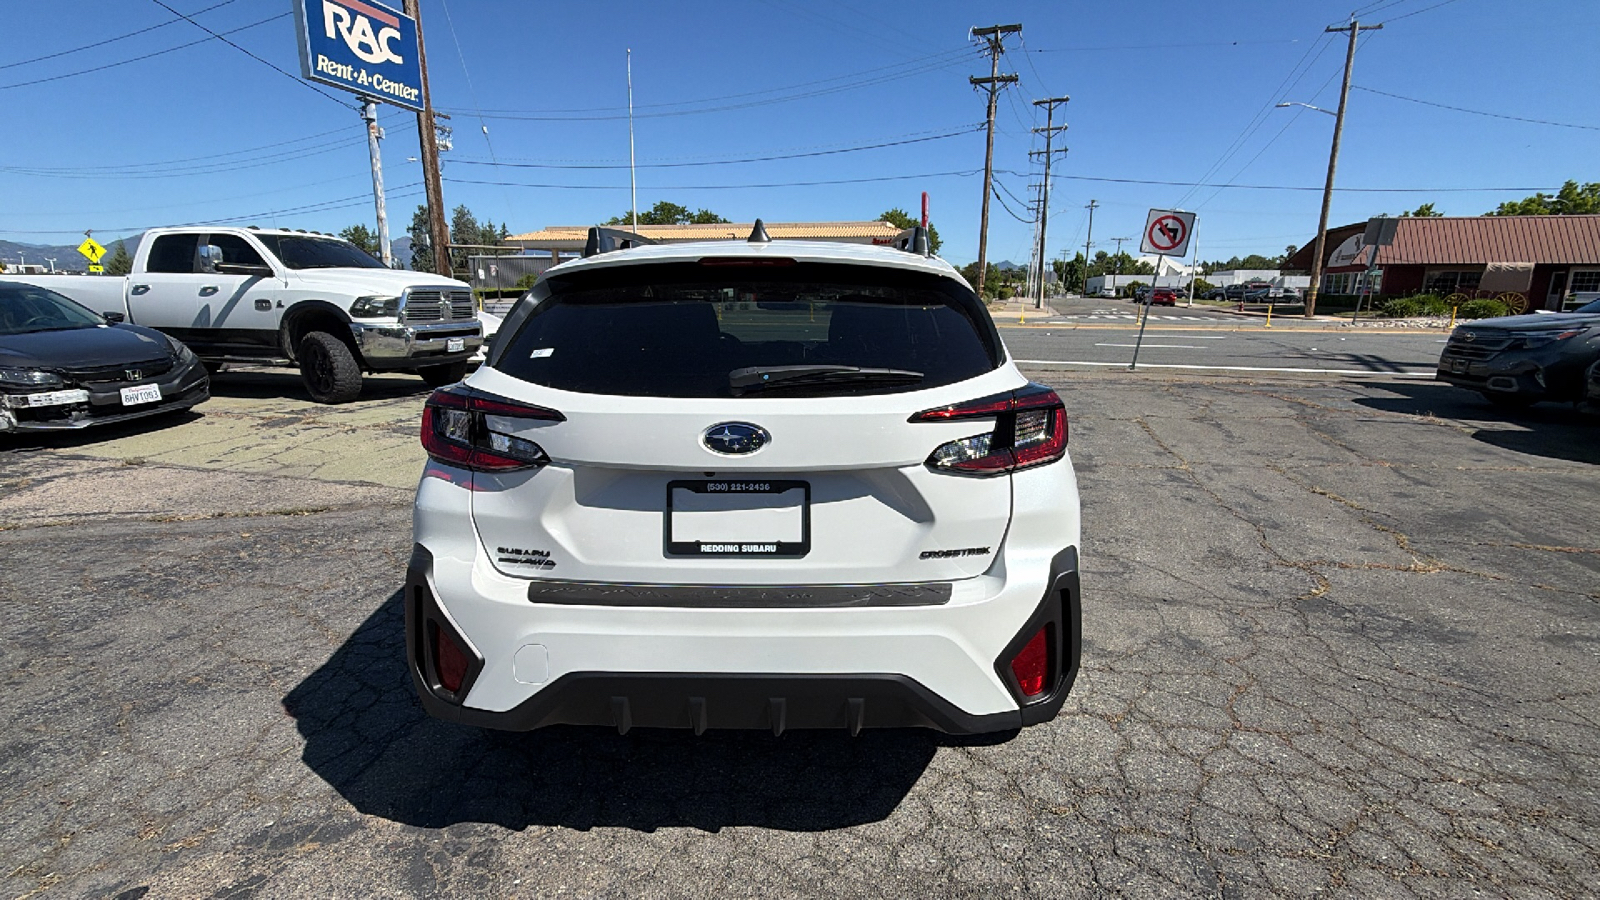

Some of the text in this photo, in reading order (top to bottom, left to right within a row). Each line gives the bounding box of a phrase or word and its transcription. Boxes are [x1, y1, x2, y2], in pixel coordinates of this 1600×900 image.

[323, 0, 403, 64] RAC
[707, 483, 770, 491] (530) 221-2436
[497, 546, 551, 557] SUBARU
[700, 544, 777, 553] REDDING SUBARU
[918, 546, 991, 560] CROSSTREK
